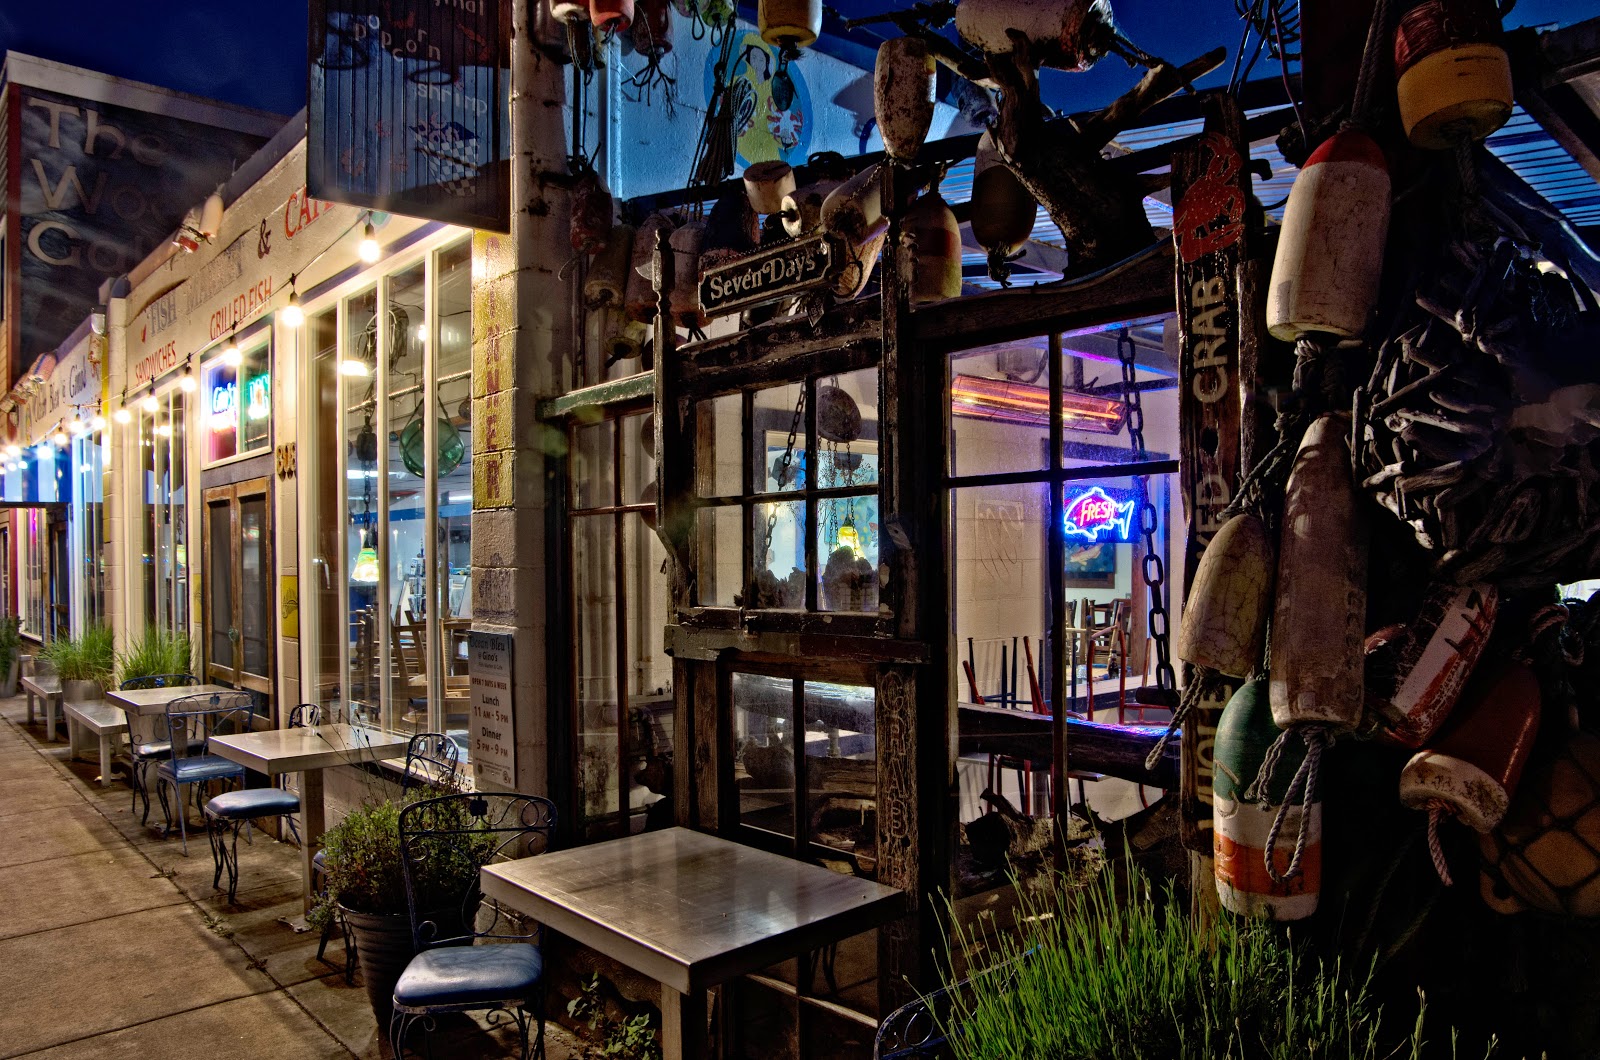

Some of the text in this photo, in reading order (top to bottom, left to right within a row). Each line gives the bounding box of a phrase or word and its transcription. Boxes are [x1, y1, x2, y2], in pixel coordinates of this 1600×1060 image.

[354, 14, 441, 62] popcorn
[417, 83, 487, 117] shrimp
[27, 97, 166, 166] The
[710, 253, 816, 301] Seven Days
[209, 293, 246, 340] GRILLED
[250, 276, 272, 316] FISH
[1192, 276, 1229, 404] CRAB
[135, 340, 176, 386] SANDWICHES
[1080, 499, 1114, 526] FRESH
[482, 651, 498, 662] Gino's
[472, 677, 480, 686] OPEN
[484, 679, 493, 688] DAYS
[473, 706, 481, 717] 11
[501, 714, 508, 724] PM
[482, 694, 500, 707] Lunch
[476, 740, 481, 750] 5
[482, 743, 490, 751] PM
[494, 744, 499, 755] 9
[500, 749, 508, 757] PM
[482, 727, 501, 740] Dinner
